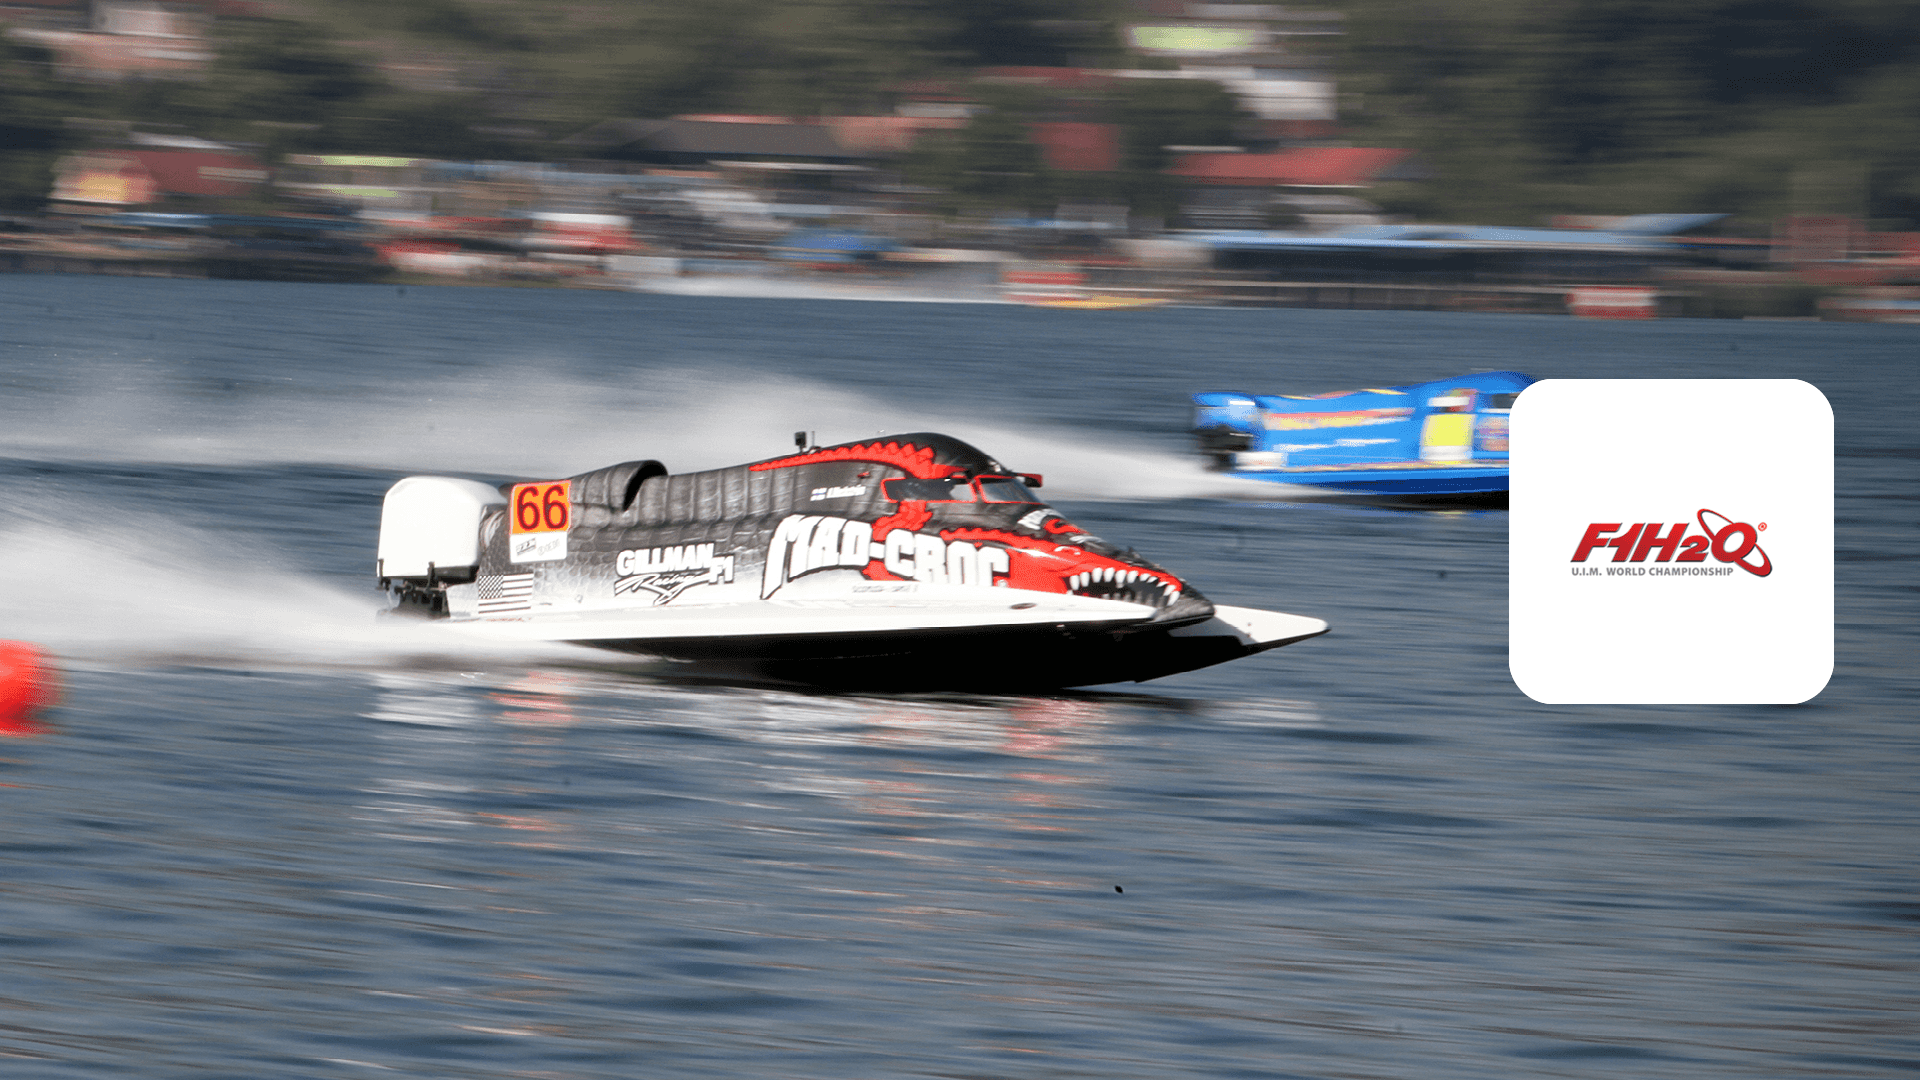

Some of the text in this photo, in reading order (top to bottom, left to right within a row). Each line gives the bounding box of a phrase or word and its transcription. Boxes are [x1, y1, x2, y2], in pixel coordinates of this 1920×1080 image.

[516, 485, 567, 531] 66
[615, 542, 715, 577] GILLMAN
[707, 554, 735, 584] F1
[760, 514, 1010, 600] MAD-CROC
